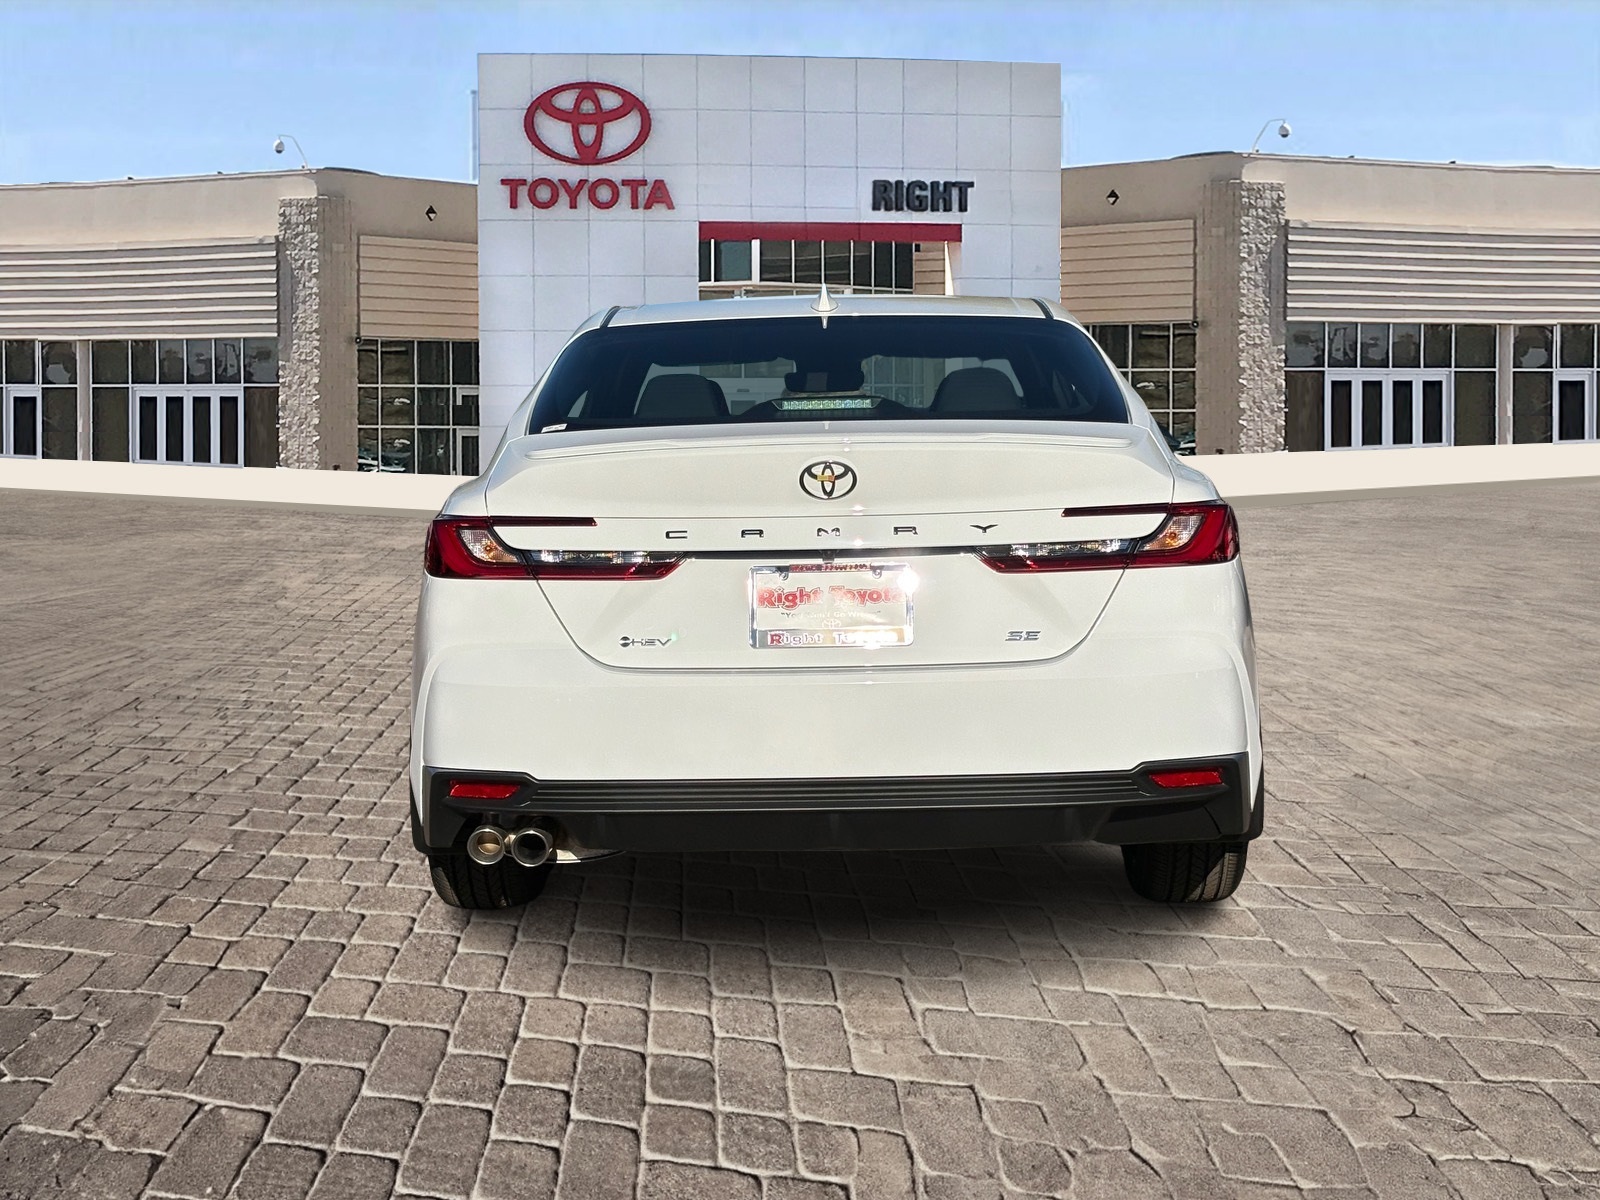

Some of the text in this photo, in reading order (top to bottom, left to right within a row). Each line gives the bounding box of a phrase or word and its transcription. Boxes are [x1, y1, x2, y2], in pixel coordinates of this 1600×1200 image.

[500, 178, 675, 210] TOYOTA
[871, 179, 975, 213] RIGHT
[665, 523, 999, 540] CAMRY
[757, 587, 823, 611] Right
[631, 638, 672, 647] HEV
[768, 631, 824, 646] Right
[1004, 630, 1042, 641] SE
